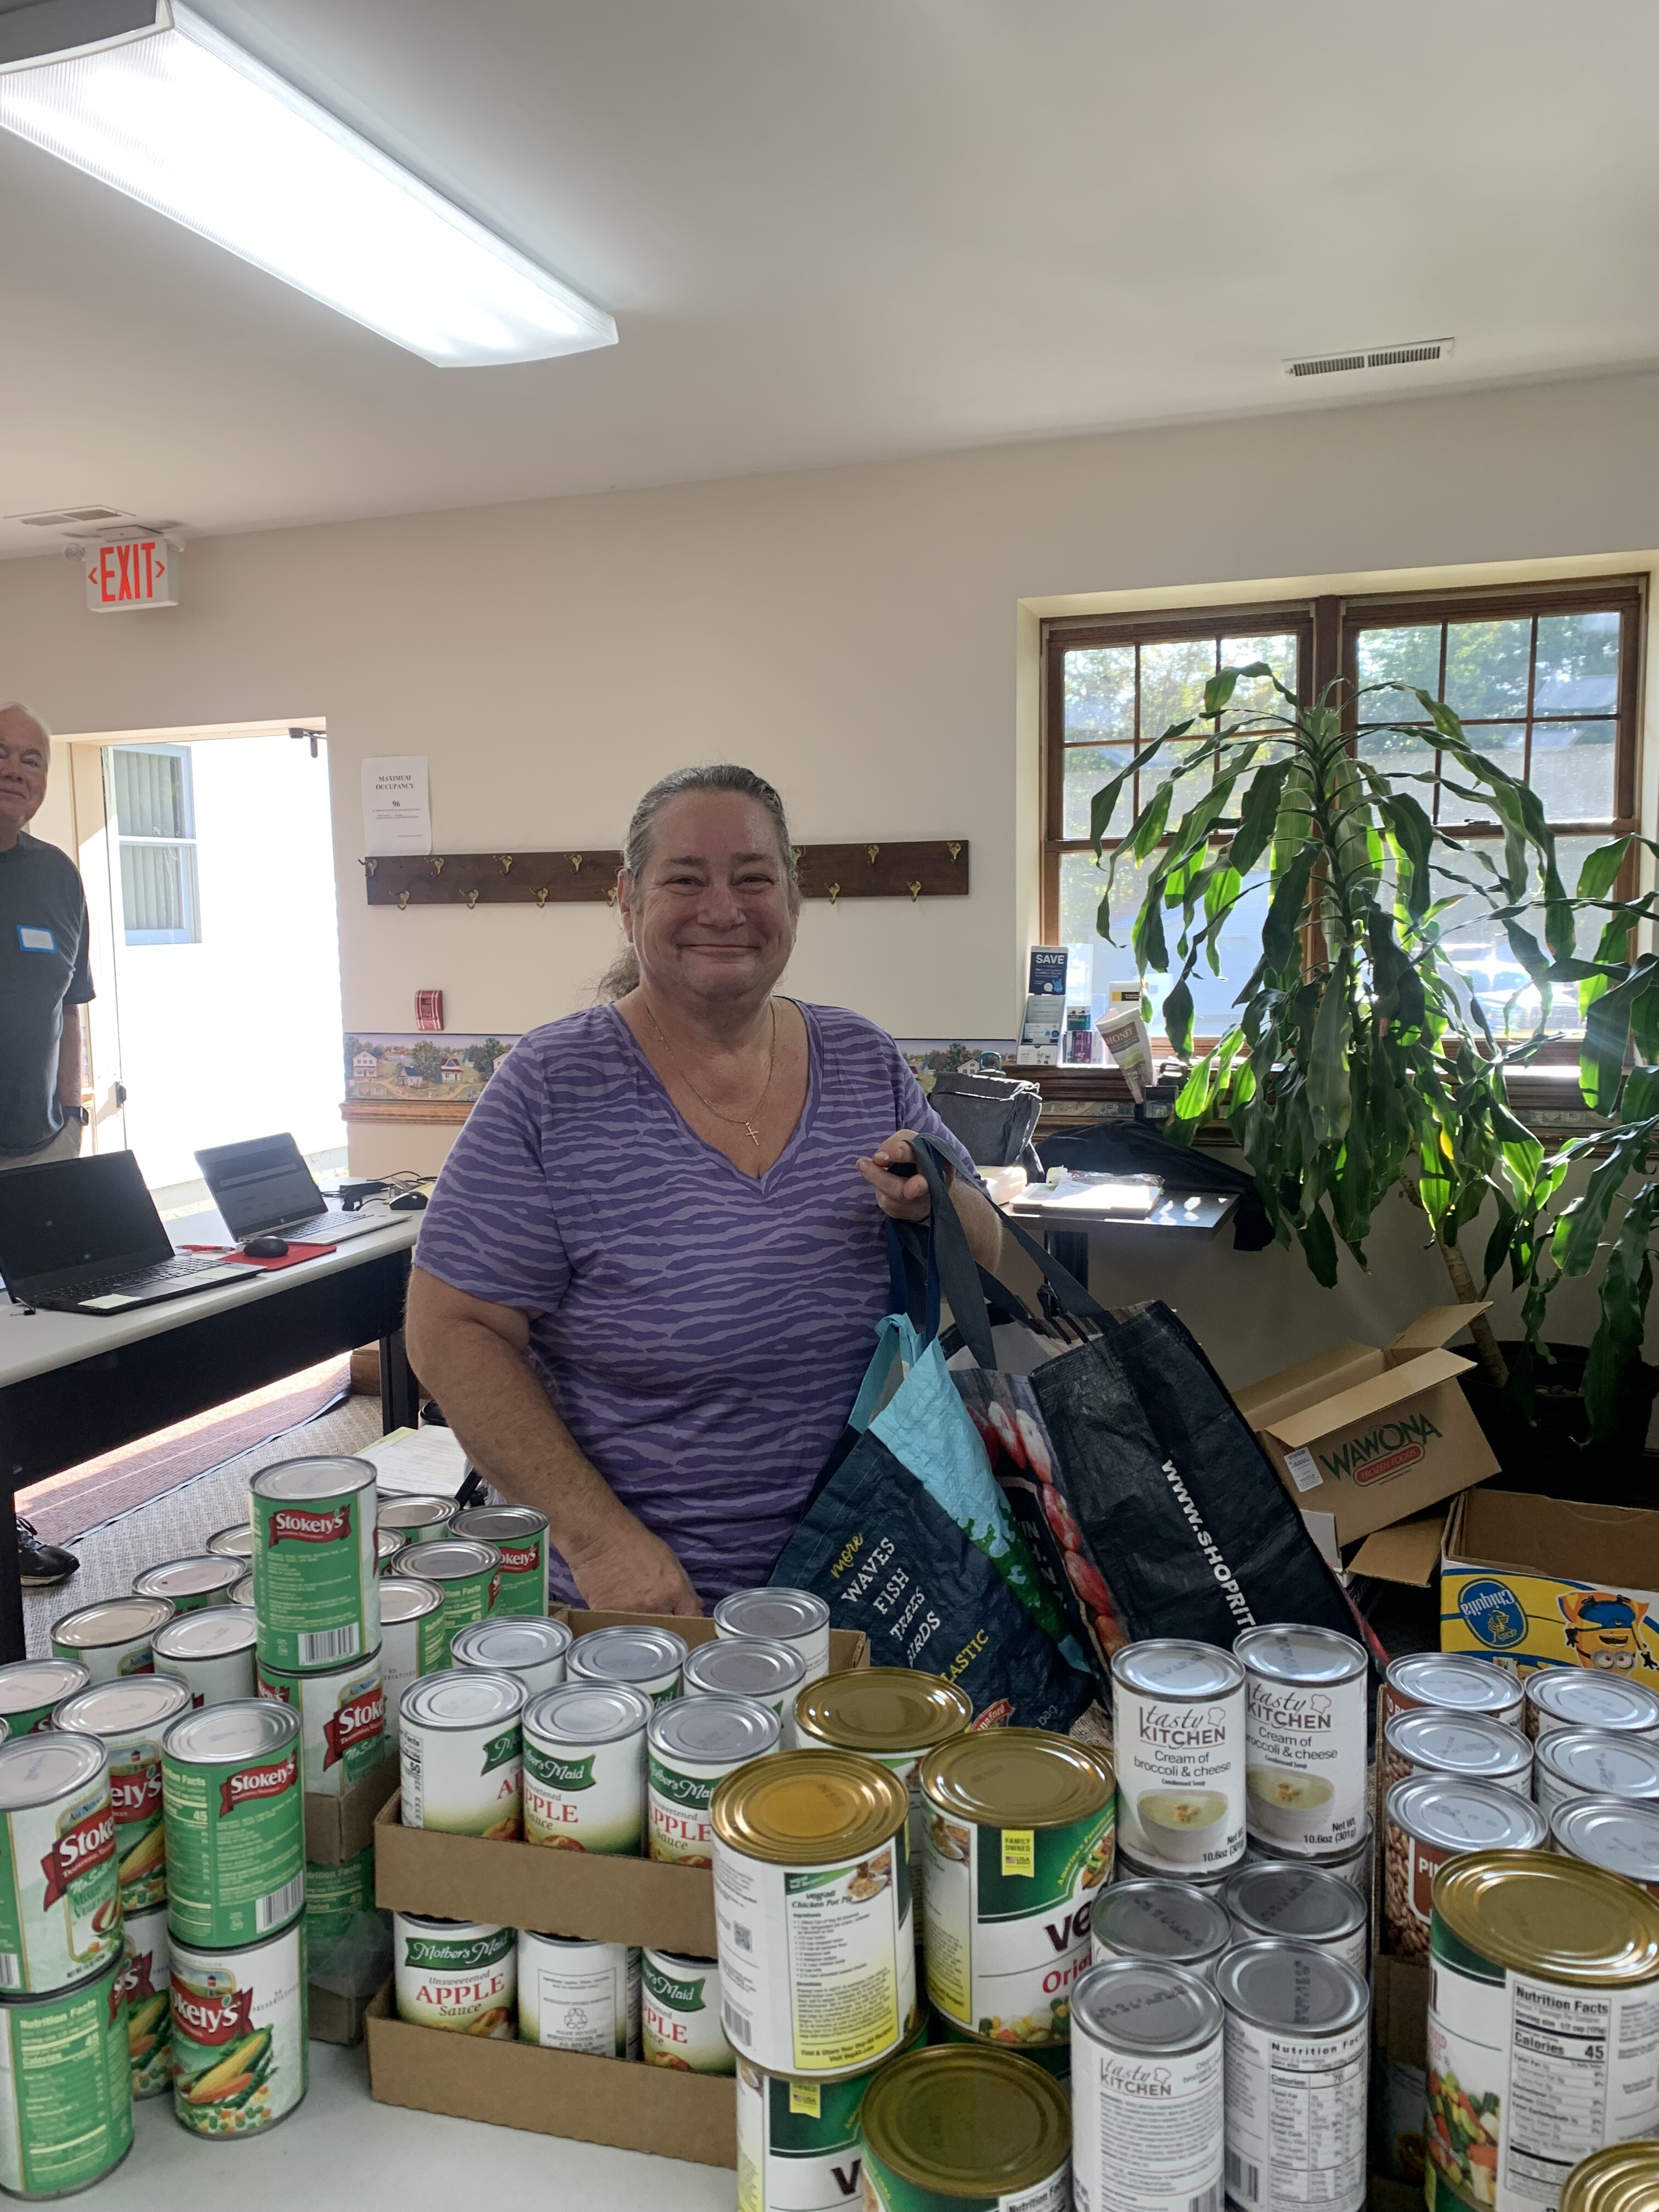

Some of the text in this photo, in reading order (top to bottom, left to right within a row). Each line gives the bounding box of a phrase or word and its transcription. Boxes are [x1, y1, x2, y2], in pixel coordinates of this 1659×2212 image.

[100, 542, 155, 602] EXIT
[1035, 954, 1065, 964] SAVE
[1105, 1026, 1133, 1045] MONEY
[1318, 1412, 1443, 1480] WAWONA
[1361, 1460, 1391, 1481] FROZEN
[1390, 1449, 1417, 1468] FOODS
[276, 1512, 344, 1534] Stokely's
[830, 1533, 864, 1579] more
[1161, 1459, 1258, 1634] WWW.SHOPRIT
[841, 1537, 895, 1602] WAVES
[872, 1567, 910, 1615] FISH
[1460, 1589, 1515, 1616] Chiquita
[890, 1585, 926, 1641] TREES
[1248, 1694, 1331, 1729] KITCHEN
[1252, 1683, 1306, 1716] tasty
[1146, 1706, 1204, 1731] tasty
[1139, 1716, 1226, 1748] KITCHEN
[1259, 1727, 1312, 1747] Cream of
[1155, 1750, 1210, 1764] Cream of
[1245, 1734, 1338, 1760] roccoli & cheese
[230, 1763, 295, 1794] Stokely's
[410, 1762, 421, 1774] 50
[540, 1760, 585, 1781] Maid
[1133, 1756, 1231, 1777] broccoli & cheese
[194, 1810, 207, 1821] 45
[1333, 1822, 1345, 1832] Net
[1227, 1836, 1238, 1846] Net
[1304, 1827, 1357, 1844] 10.6oz (301g)
[1203, 1849, 1228, 1862] 10.6oz
[792, 1900, 824, 1908] Chicken
[826, 1899, 839, 1907] Pot
[416, 1972, 505, 2006] APPLE
[429, 1970, 490, 1985] Unsweetened
[652, 1976, 695, 2001] Maid
[439, 2003, 482, 2017] Sauce
[1516, 1985, 1571, 2011] Nutrition
[1575, 2000, 1609, 2015] Facts
[20, 1999, 97, 2029] Nutrition Facts
[1272, 2042, 1337, 2056] Nutrition
[1515, 2031, 1565, 2056] Calories
[1584, 2044, 1605, 2060] 45
[1101, 2066, 1172, 2096] KITCHEN
[1105, 2058, 1151, 2084] tasty
[1271, 2074, 1306, 2086] Calories
